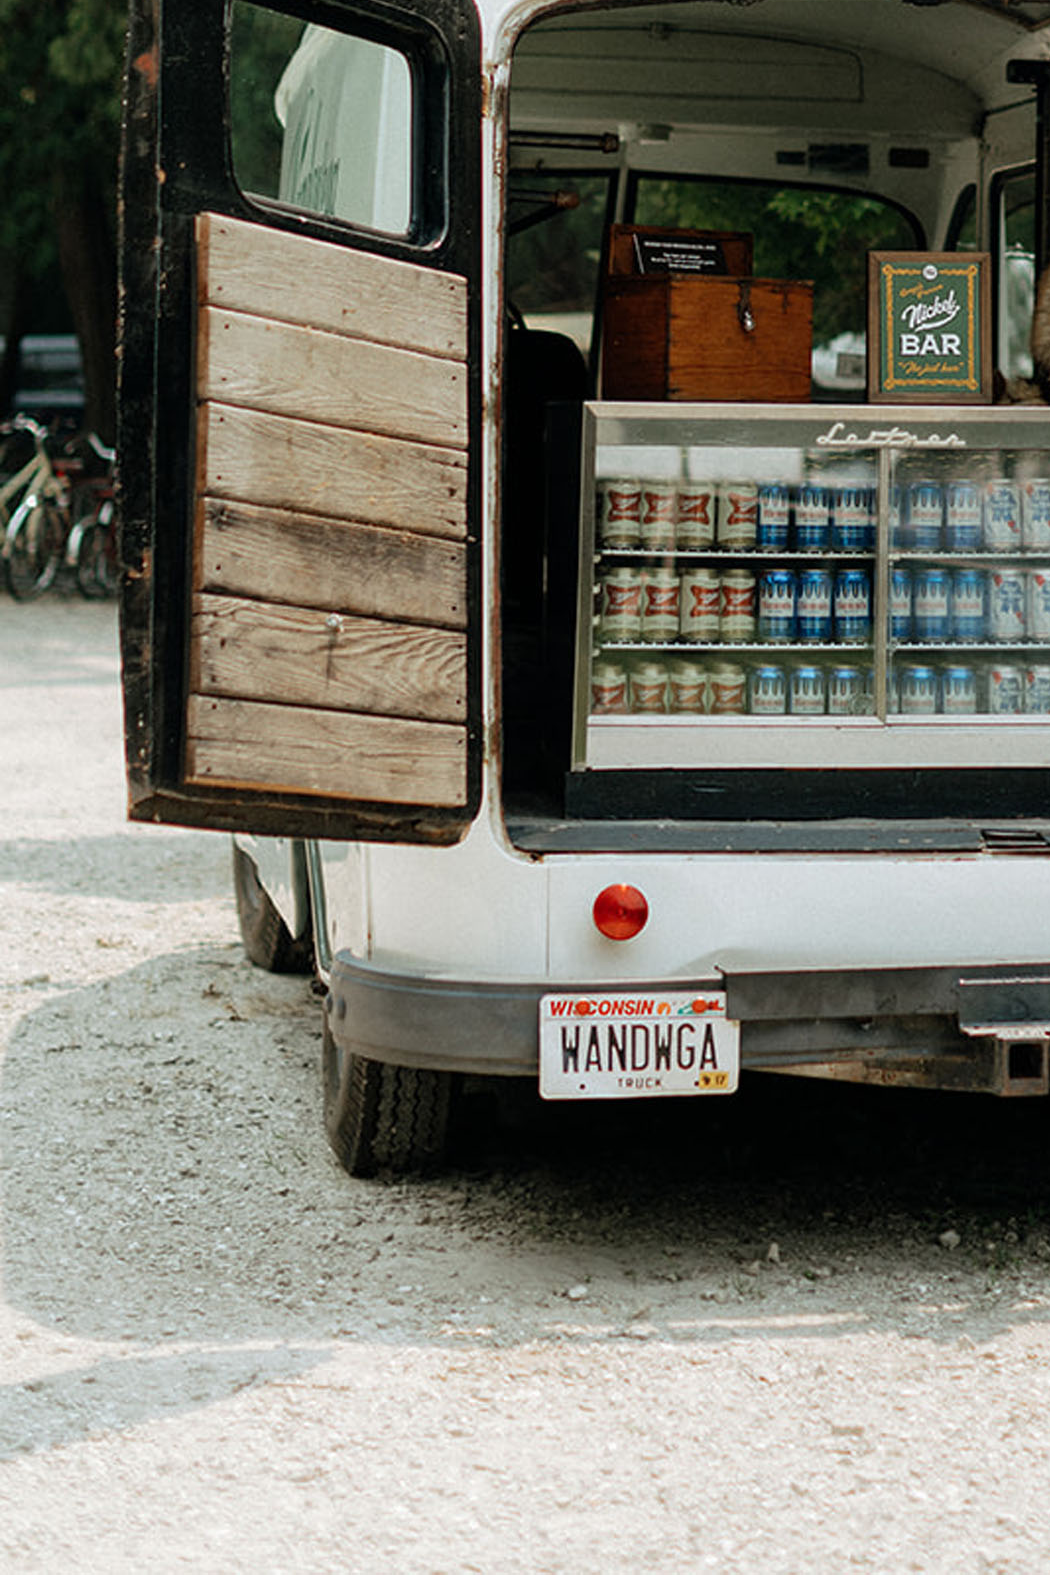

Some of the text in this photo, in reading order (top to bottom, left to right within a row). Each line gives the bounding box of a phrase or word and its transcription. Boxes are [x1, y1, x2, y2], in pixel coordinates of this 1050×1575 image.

[901, 289, 960, 332] Nickel
[900, 333, 961, 356] BAR
[550, 999, 655, 1017] WICONSIN
[561, 1023, 717, 1074] WANDWGA
[618, 1076, 662, 1089] TRUCK
